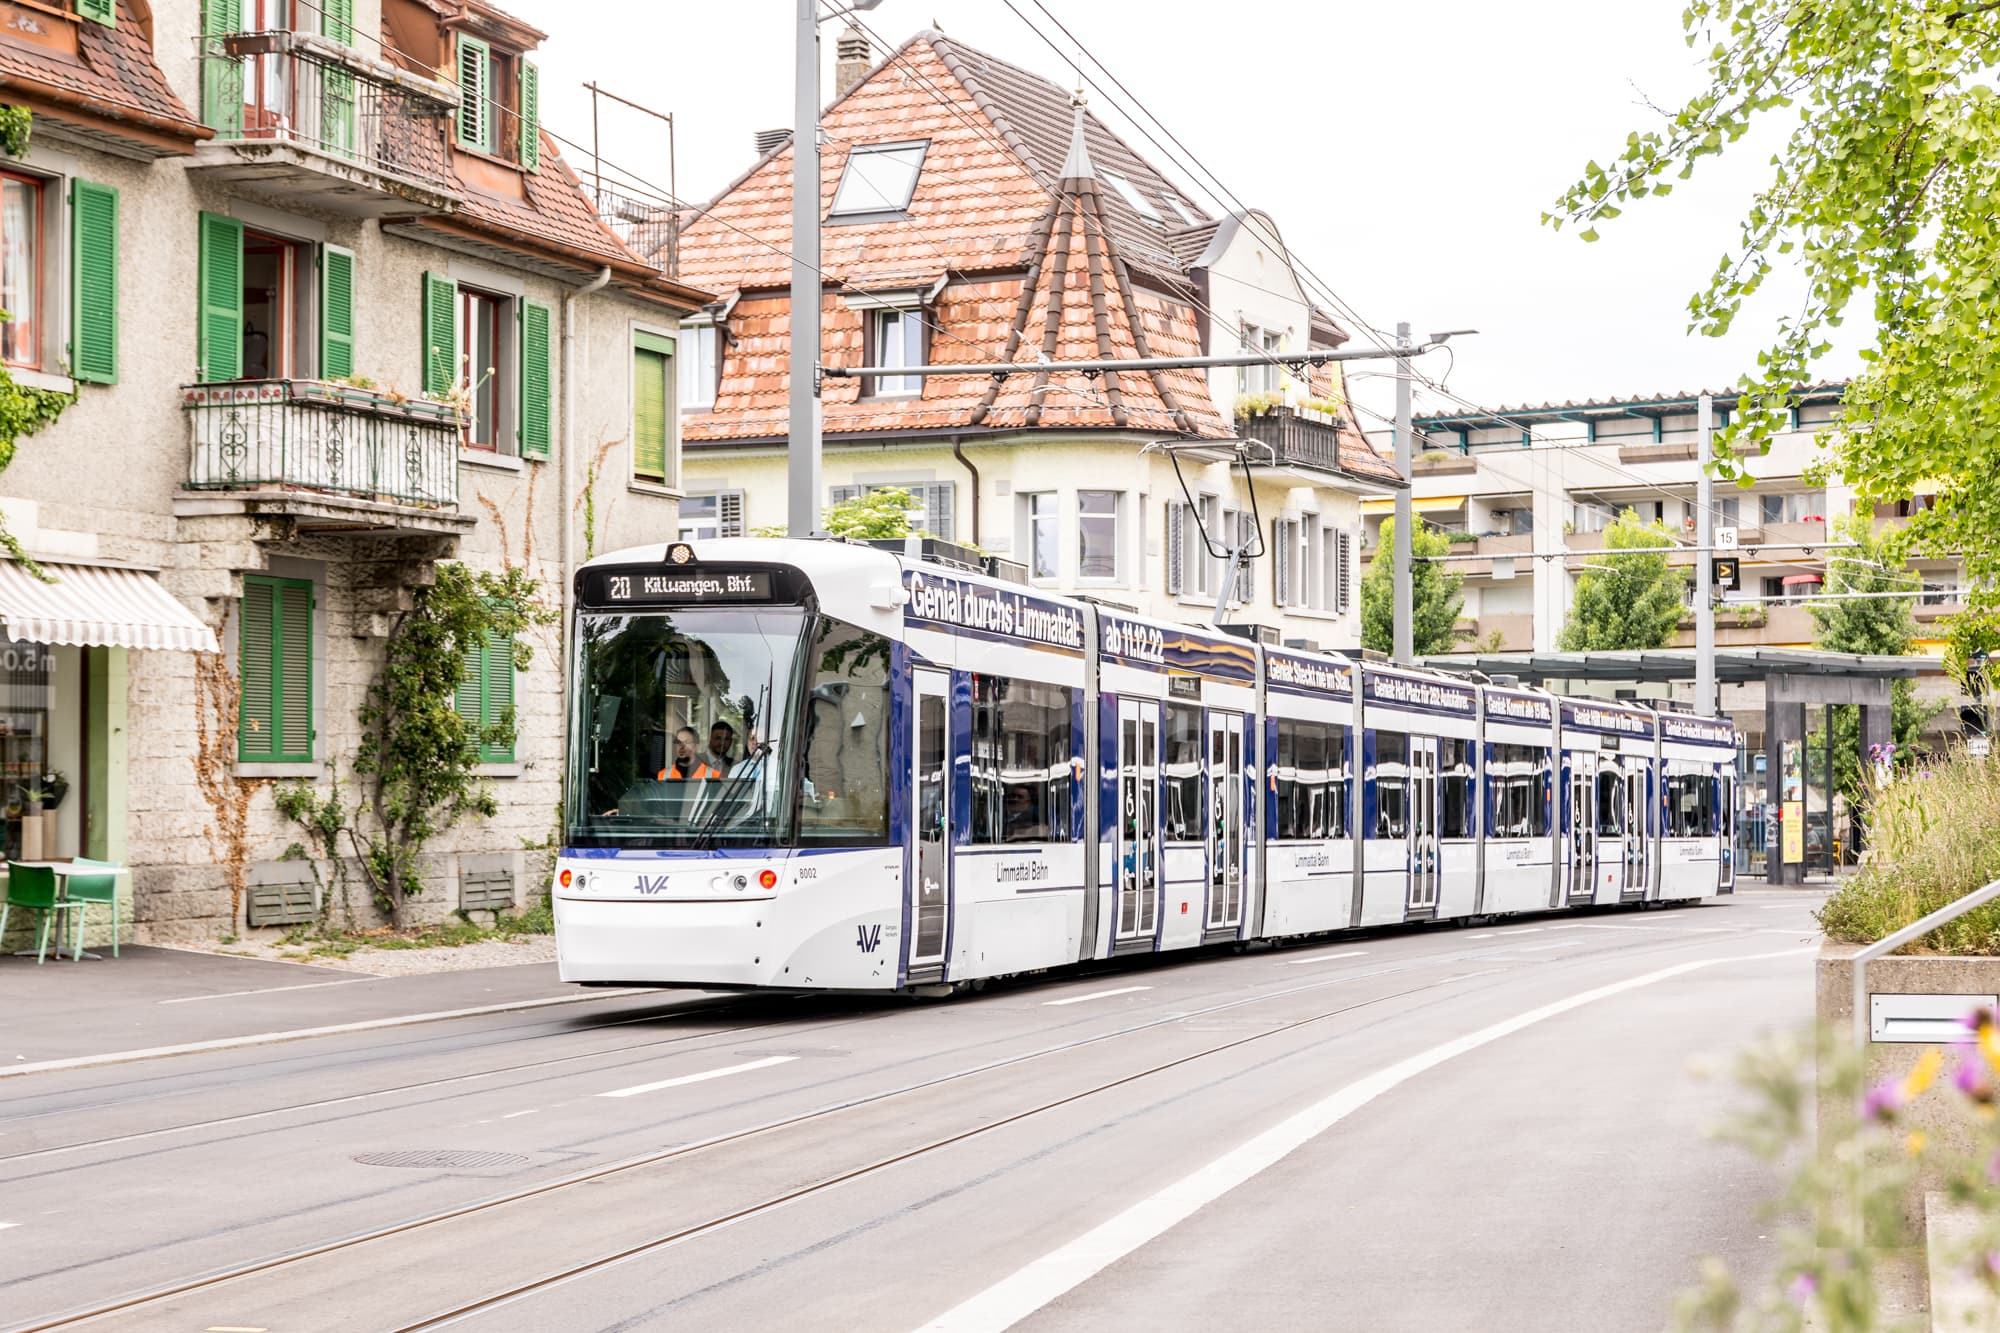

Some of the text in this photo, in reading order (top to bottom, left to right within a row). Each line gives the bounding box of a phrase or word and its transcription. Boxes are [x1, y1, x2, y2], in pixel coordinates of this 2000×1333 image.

[1720, 532, 1733, 544] 15
[609, 575, 756, 599] 20 Killwangen, Bhf.
[910, 571, 1081, 648] Genial durchs Limmattal:
[1105, 617, 1165, 664] ab 11.12.22
[1270, 656, 1294, 682] Genial:
[1293, 660, 1315, 687] Steckt
[800, 867, 817, 879] 8002
[996, 859, 1048, 883] Limmattal Bahn
